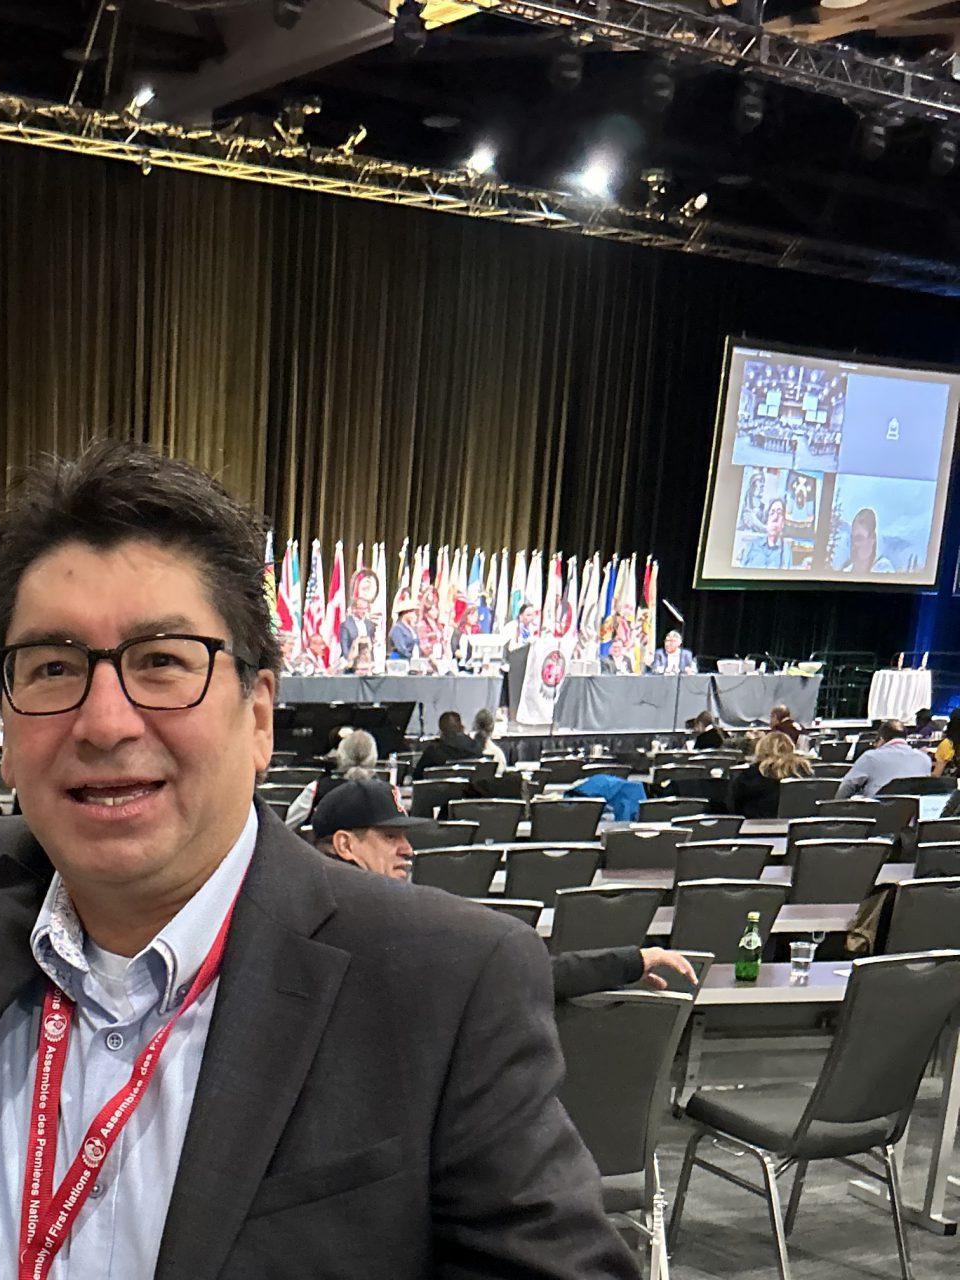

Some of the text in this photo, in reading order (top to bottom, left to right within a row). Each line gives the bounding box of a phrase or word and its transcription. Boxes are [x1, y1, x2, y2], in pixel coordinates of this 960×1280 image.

[39, 1045, 57, 1109] Assemblée
[37, 1114, 46, 1135] des
[31, 1138, 46, 1196] Premières
[63, 1169, 91, 1211] Nations
[48, 1211, 68, 1238] First
[44, 1235, 55, 1249] of
